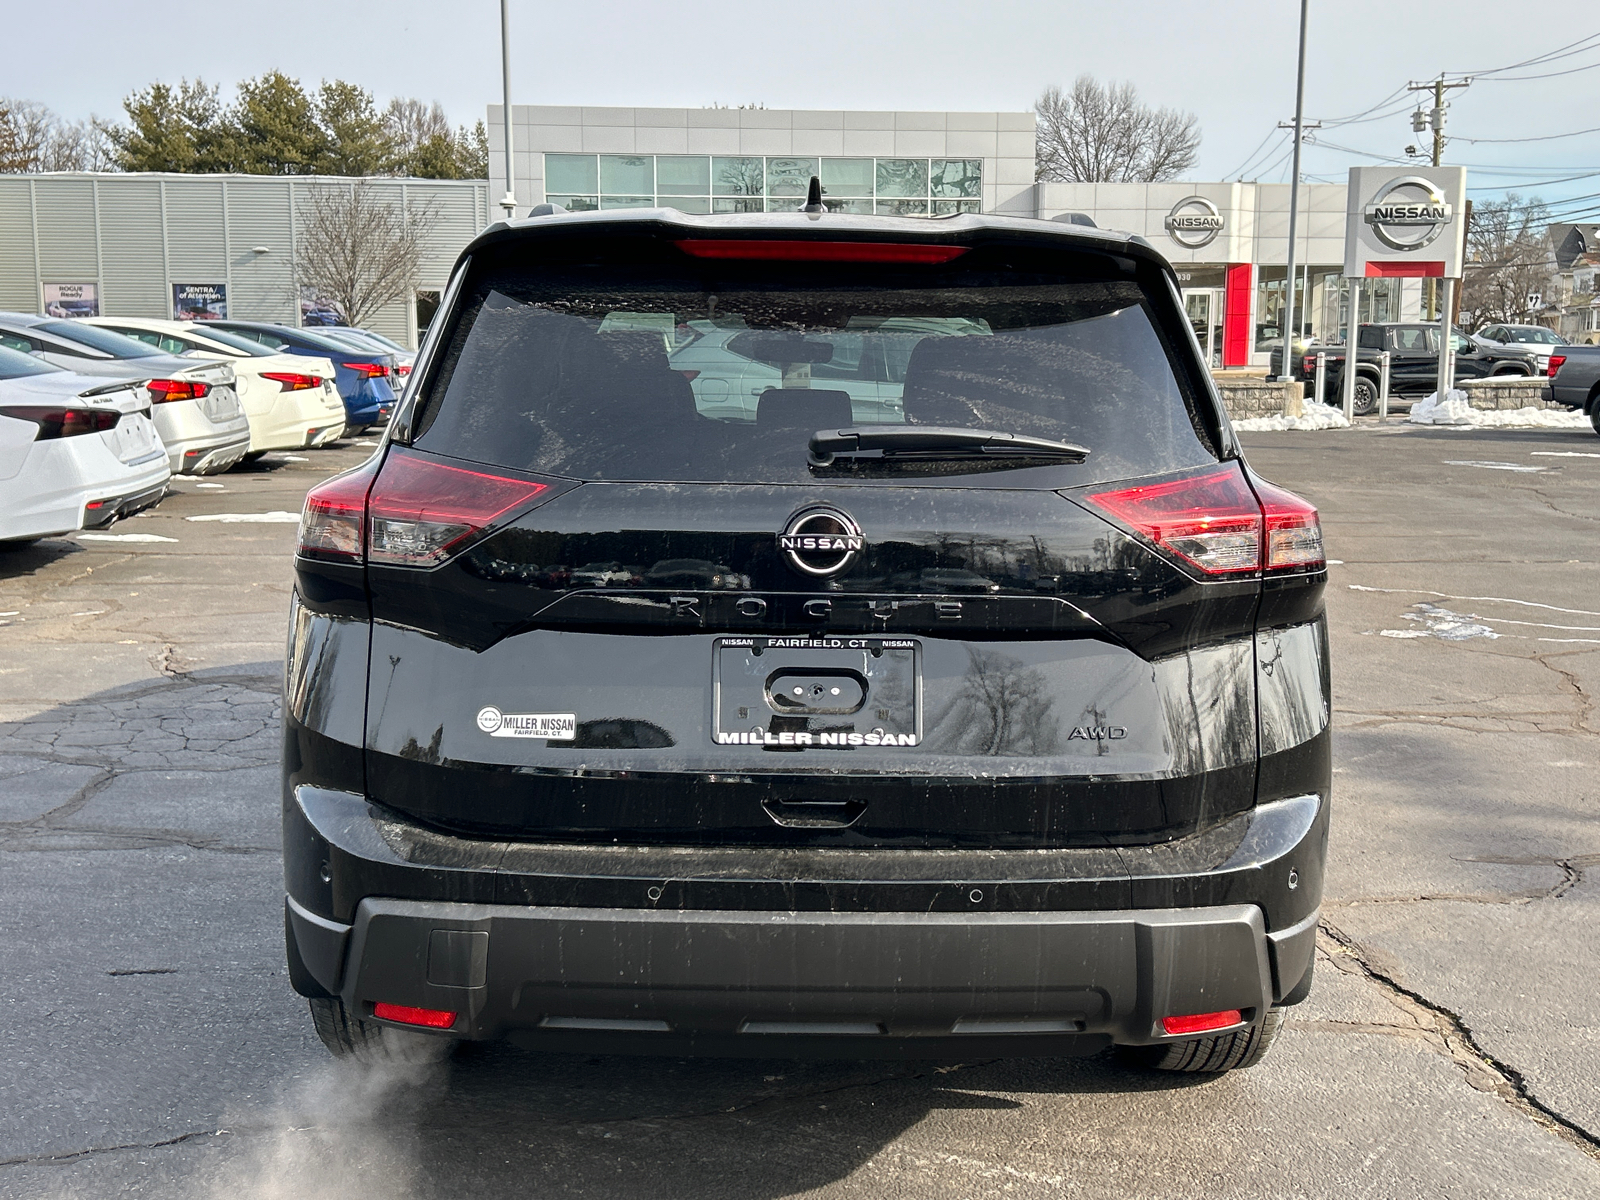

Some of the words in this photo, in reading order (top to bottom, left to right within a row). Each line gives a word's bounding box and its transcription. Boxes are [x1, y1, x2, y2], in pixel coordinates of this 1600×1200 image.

[1374, 207, 1445, 219] NISSAN
[1171, 218, 1219, 227] NISSAN
[781, 537, 863, 550] NISSAN
[669, 596, 963, 620] ROGUE
[767, 639, 845, 648] FAIRFIELD,
[848, 639, 869, 648] CT
[503, 717, 537, 730] MILLER
[540, 718, 574, 731] NISSAN
[514, 729, 550, 737] FAIRFIELD,
[718, 732, 812, 745] MILLER
[820, 733, 916, 746] NISSAN
[1067, 725, 1129, 741] AWD
